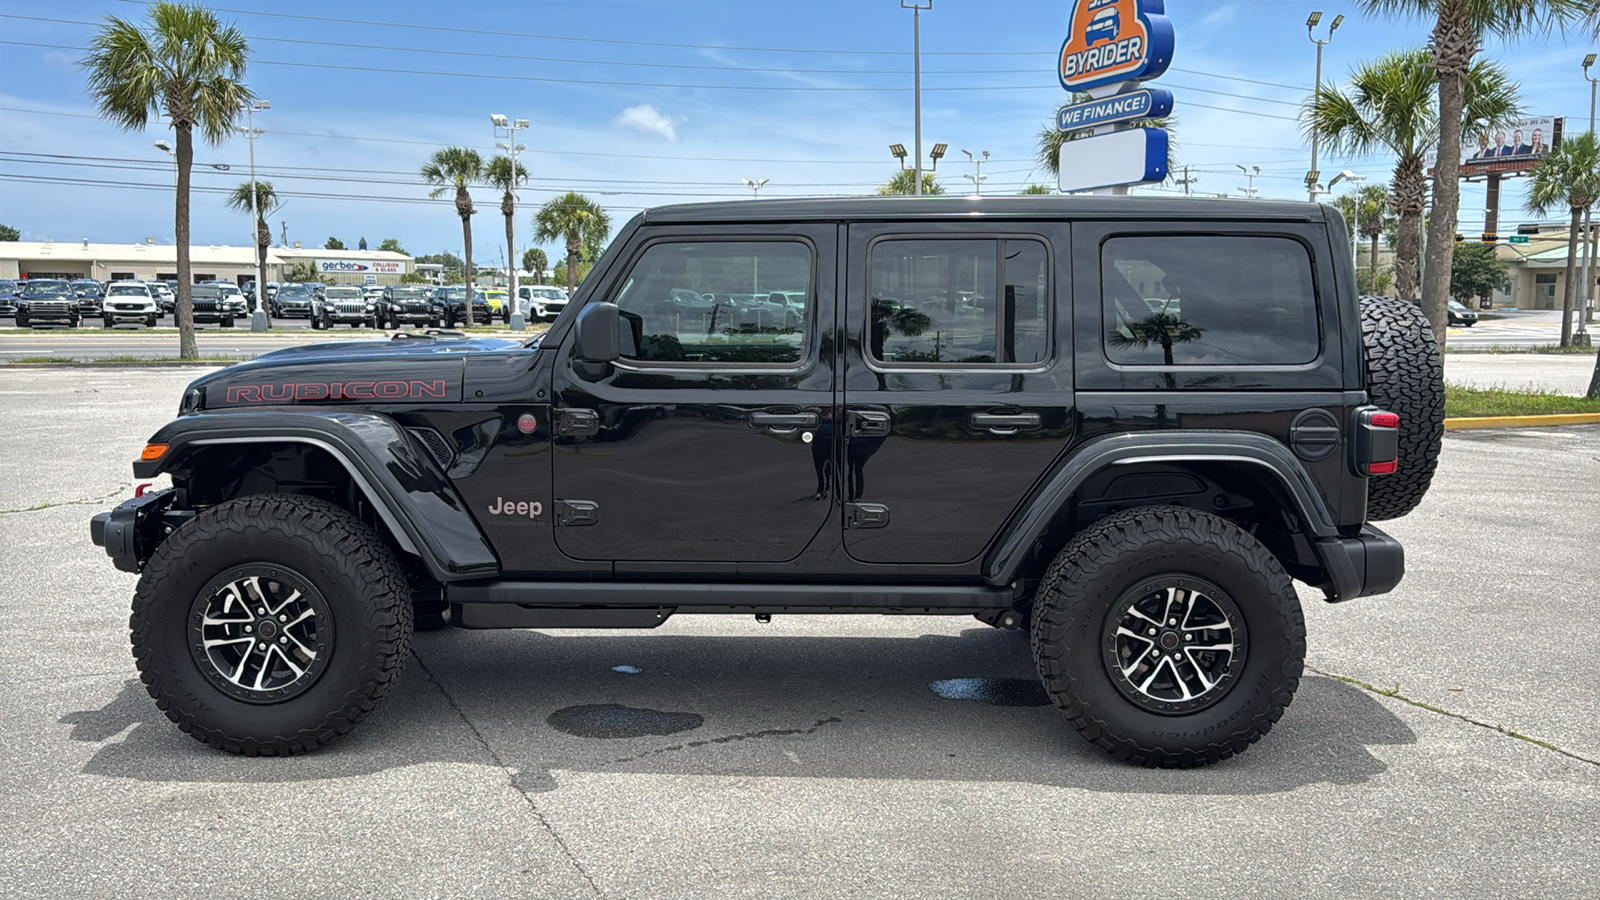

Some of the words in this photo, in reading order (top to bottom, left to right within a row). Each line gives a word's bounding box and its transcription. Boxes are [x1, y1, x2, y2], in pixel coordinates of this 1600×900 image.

[1064, 37, 1142, 77] BYRIDER
[1061, 110, 1080, 125] WE
[1082, 96, 1146, 121] FINANCE!
[322, 261, 357, 271] gerber
[226, 380, 446, 403] RUBICON
[488, 496, 543, 519] Jeep
